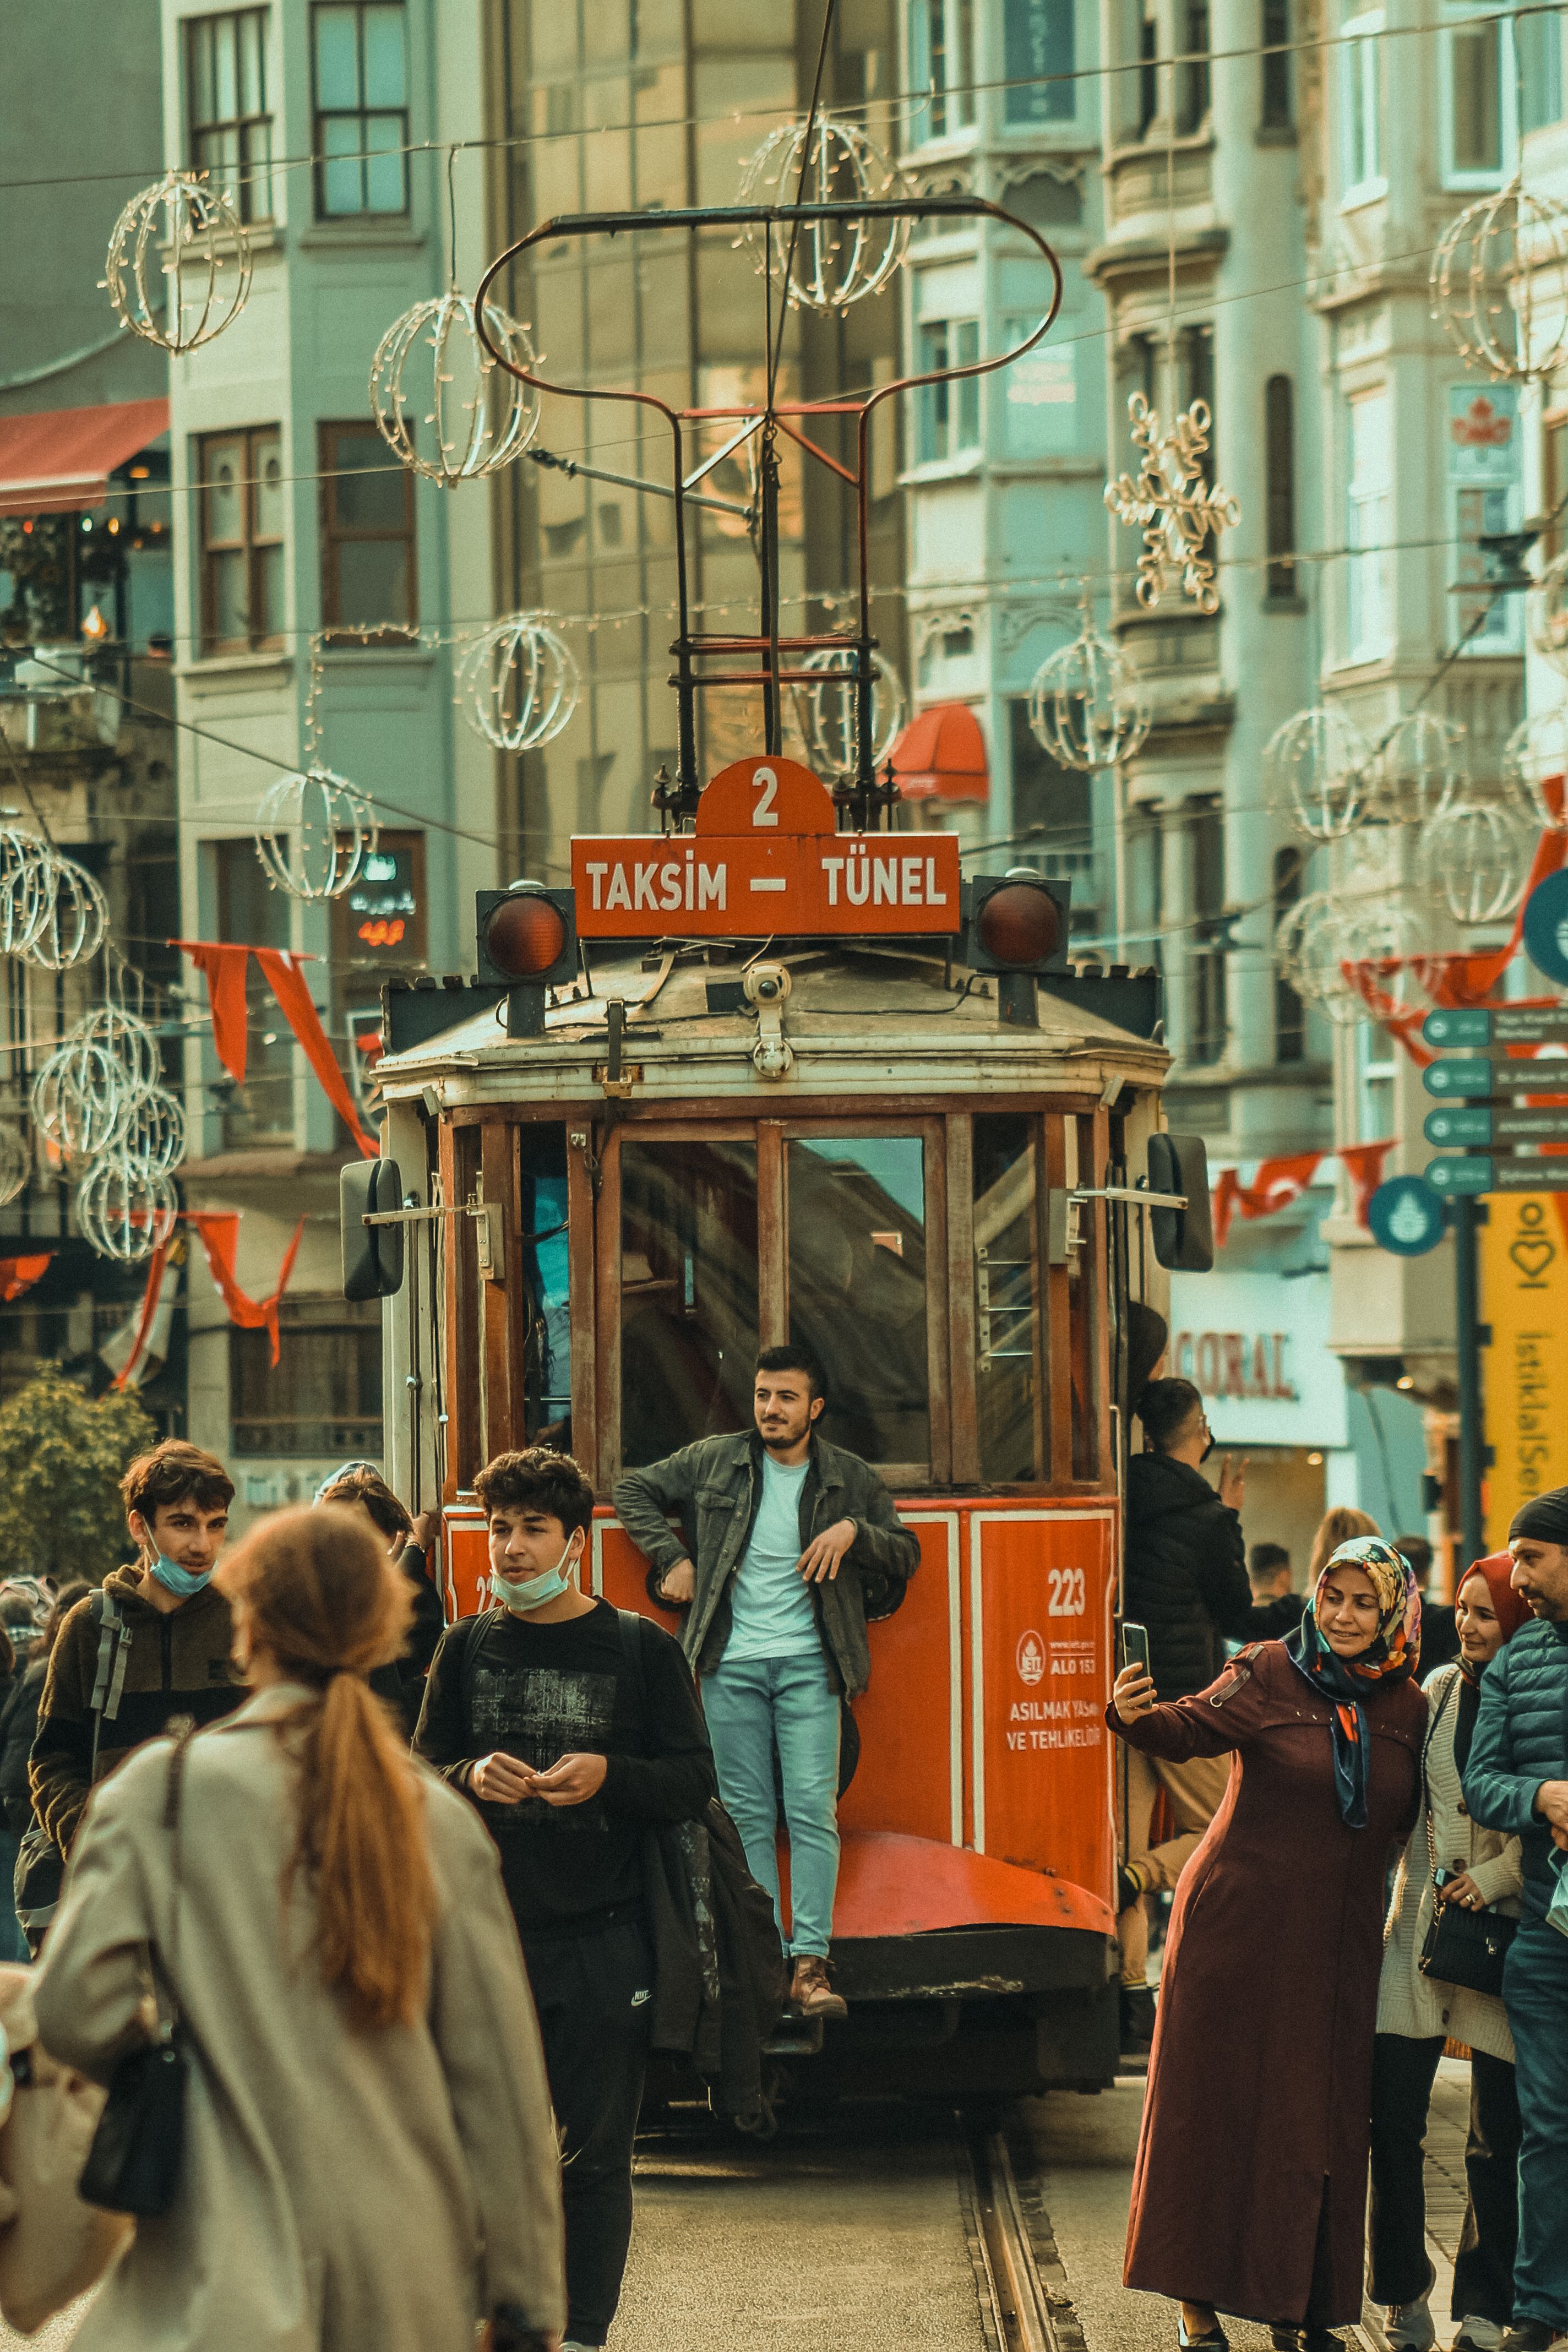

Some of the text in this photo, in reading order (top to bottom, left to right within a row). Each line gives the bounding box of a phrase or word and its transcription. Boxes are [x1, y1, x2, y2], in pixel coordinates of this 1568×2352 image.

[752, 767, 779, 827] 2
[586, 849, 727, 911] TAKSİM
[821, 843, 948, 906] TÜNEL
[1173, 1331, 1294, 1400] CORAL
[1048, 1568, 1086, 1617] 223
[1010, 1701, 1071, 1722] ASILMAK
[1006, 1731, 1027, 1751] VE
